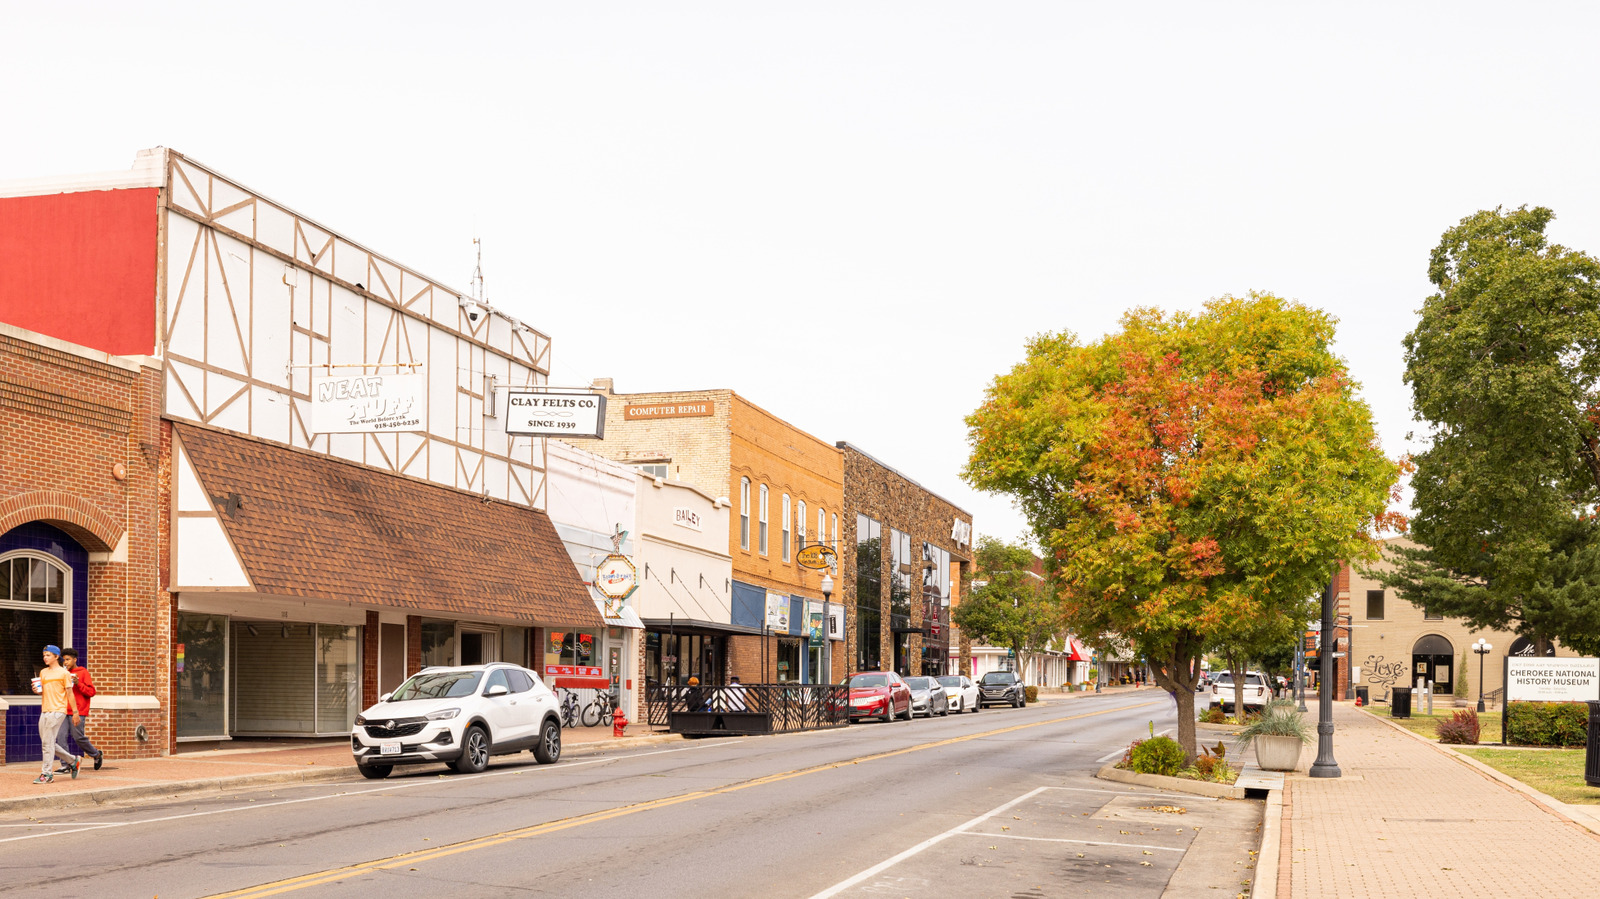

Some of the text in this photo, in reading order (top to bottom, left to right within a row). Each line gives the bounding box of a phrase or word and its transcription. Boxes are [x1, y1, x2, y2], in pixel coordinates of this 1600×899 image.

[319, 377, 383, 402] NEAT
[511, 398, 596, 408] CLAY FELTS CO.
[629, 405, 706, 416] COMPUTER REPAIR
[557, 421, 576, 429] 1939
[676, 509, 701, 527] BAILEY
[1362, 655, 1408, 684] Love
[1510, 669, 1597, 678] CHEROKEE NATIONAL
